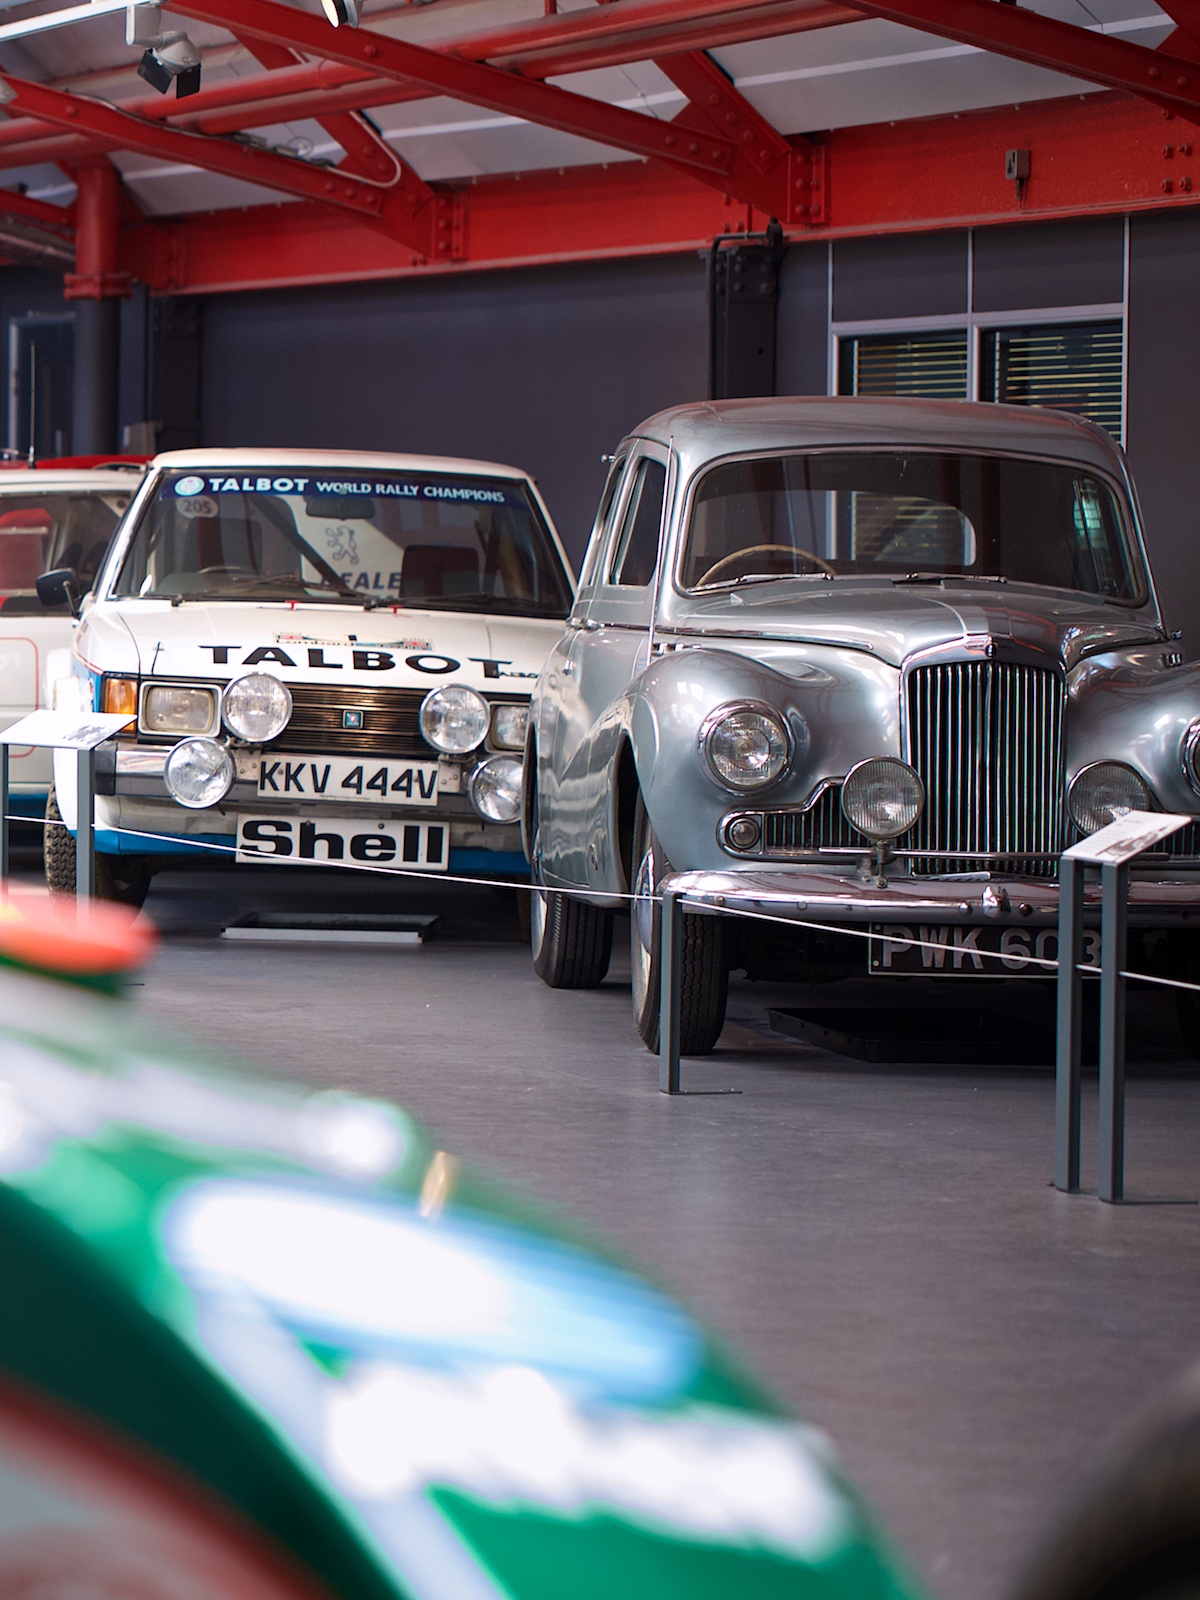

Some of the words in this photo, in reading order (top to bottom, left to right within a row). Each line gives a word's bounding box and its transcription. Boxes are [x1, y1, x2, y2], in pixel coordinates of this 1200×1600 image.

[184, 500, 212, 514] 205
[209, 478, 309, 492] TALBOT
[316, 481, 372, 494] WORLD
[375, 484, 419, 496] RALLY
[423, 486, 505, 503] CHAMPIONS
[198, 645, 513, 679] TALBOT
[259, 761, 332, 793] KKV
[341, 765, 438, 799] 444V
[240, 820, 443, 864] Shell
[882, 925, 984, 969] PWK
[1000, 927, 1102, 970] 603
